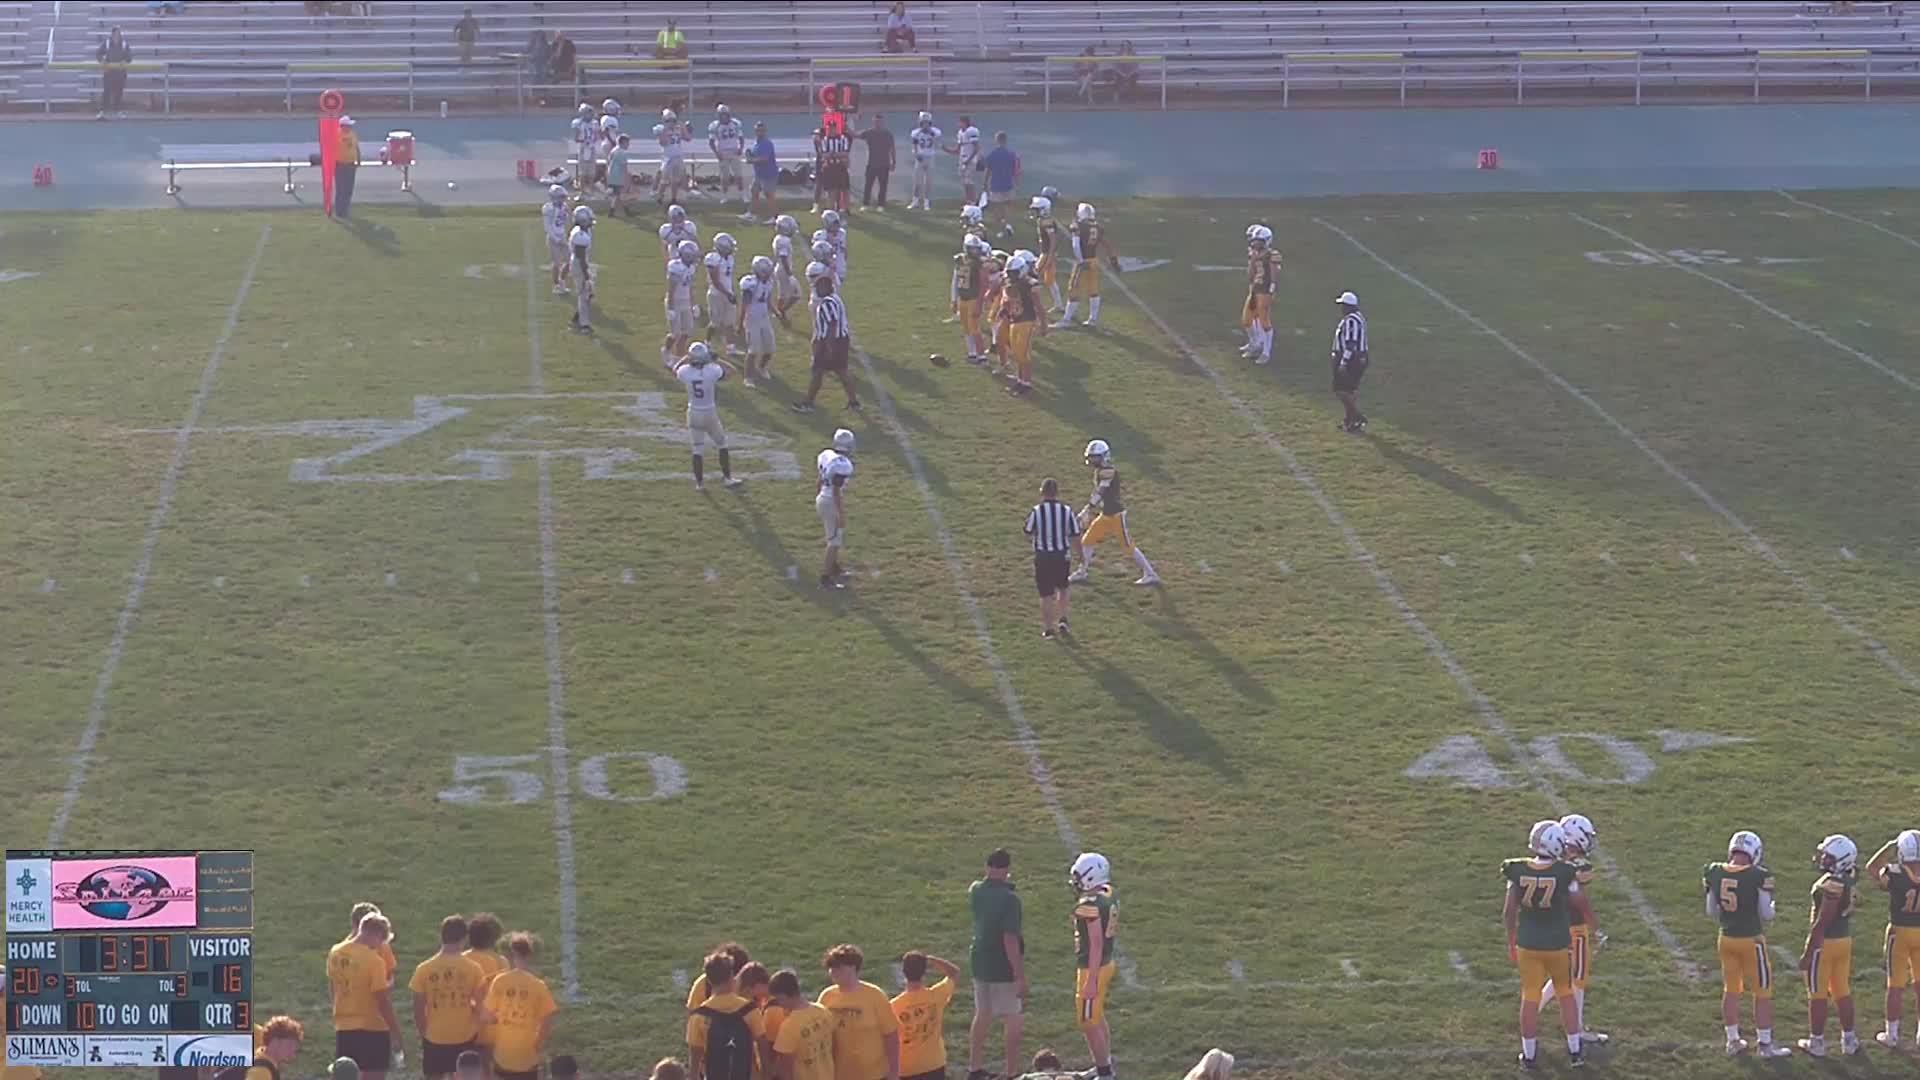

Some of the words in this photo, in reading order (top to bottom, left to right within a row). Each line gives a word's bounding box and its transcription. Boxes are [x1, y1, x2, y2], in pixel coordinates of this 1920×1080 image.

[692, 380, 704, 400] 5
[1404, 732, 1656, 788] 40
[437, 752, 689, 806] 50
[1519, 876, 1556, 909] 77
[1720, 878, 1738, 913] 5
